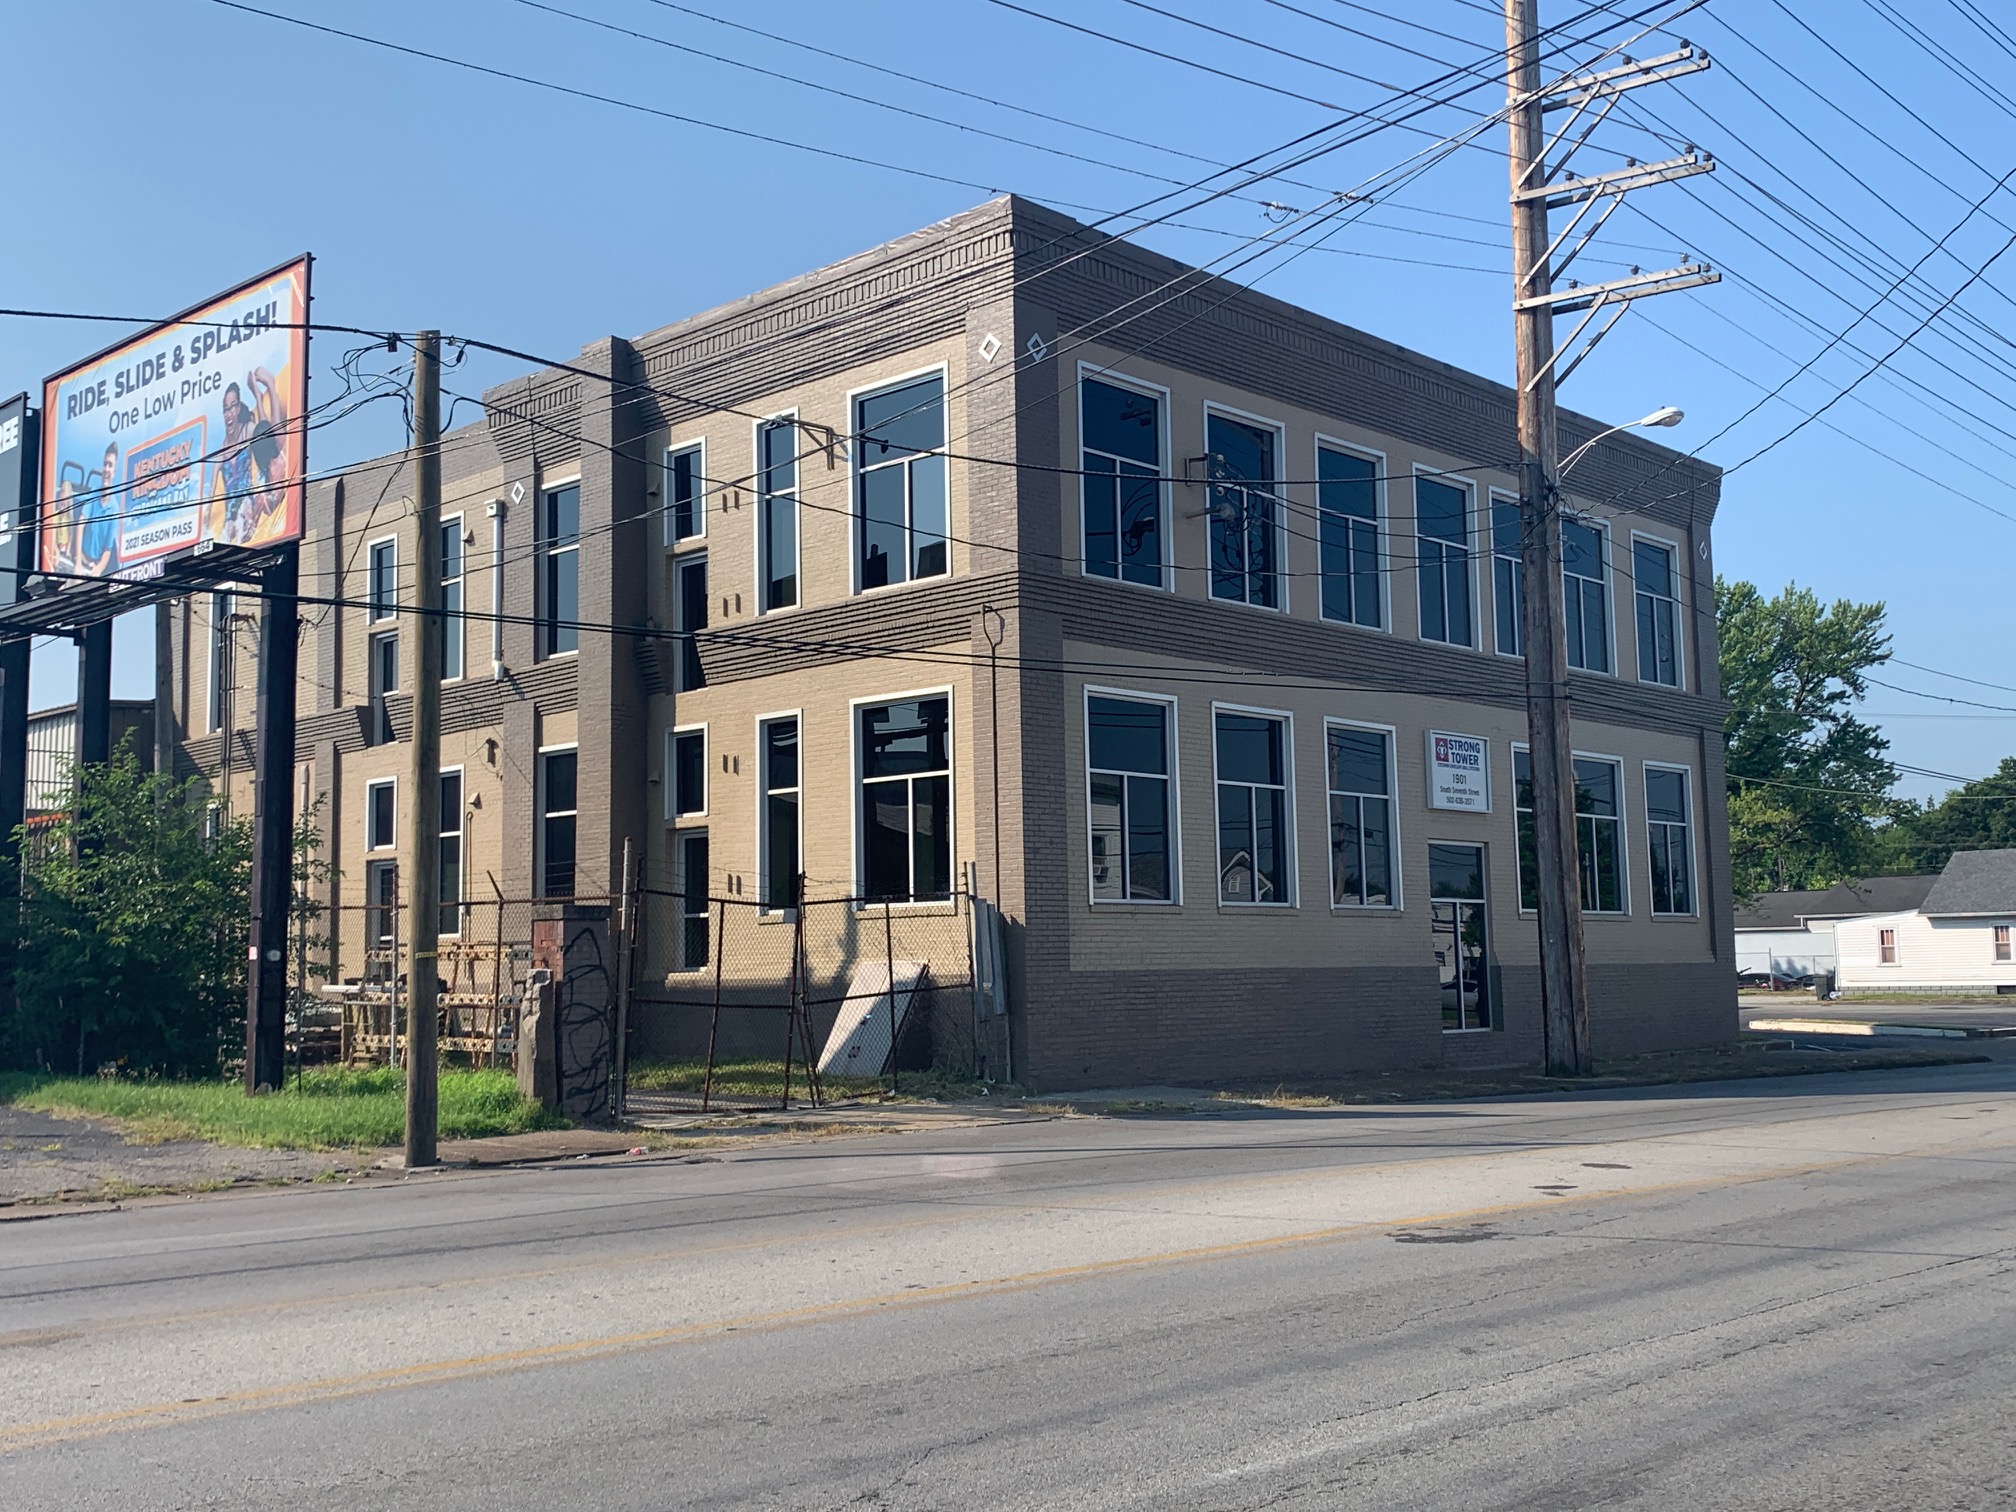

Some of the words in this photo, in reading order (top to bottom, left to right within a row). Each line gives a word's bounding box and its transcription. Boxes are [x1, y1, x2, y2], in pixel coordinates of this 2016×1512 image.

[67, 379, 110, 420] RIDE,
[114, 352, 167, 399] SLIDE
[171, 344, 185, 373] &
[190, 300, 278, 365] SPLASH!
[109, 406, 140, 434] One
[144, 389, 176, 420] Low
[181, 371, 222, 405] Price
[134, 439, 193, 476] KENTUCKY
[141, 528, 171, 546] SEASON
[172, 521, 193, 538] PASS
[1448, 739, 1481, 754] STRONG
[1451, 752, 1480, 766] TOWER
[1452, 773, 1467, 785] 1901
